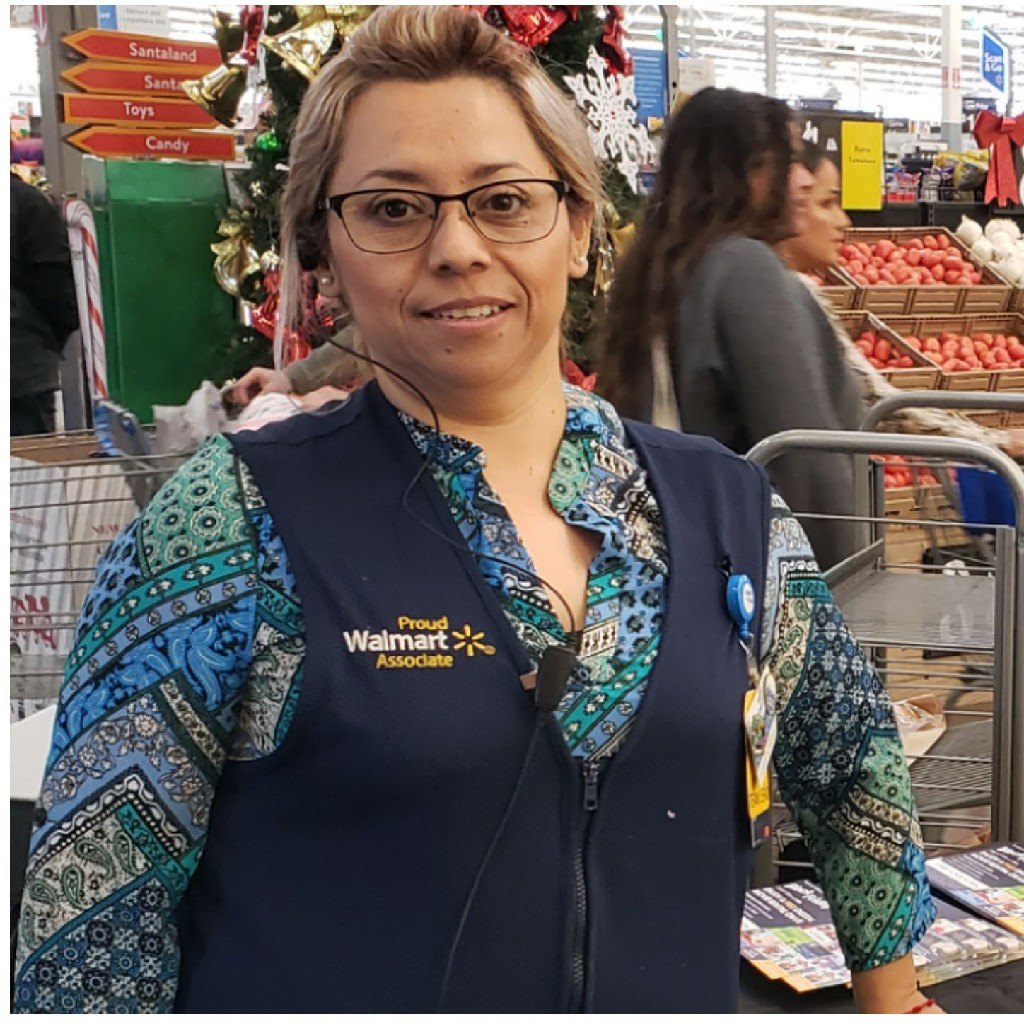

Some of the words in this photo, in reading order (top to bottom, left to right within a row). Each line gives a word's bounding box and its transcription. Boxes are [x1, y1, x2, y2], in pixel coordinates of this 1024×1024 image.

[128, 41, 198, 63] Santaland
[124, 101, 155, 119] Toys
[145, 136, 190, 154] Candy
[397, 615, 449, 631] Proud
[343, 628, 449, 653] Walmart
[376, 653, 454, 669] Associate
